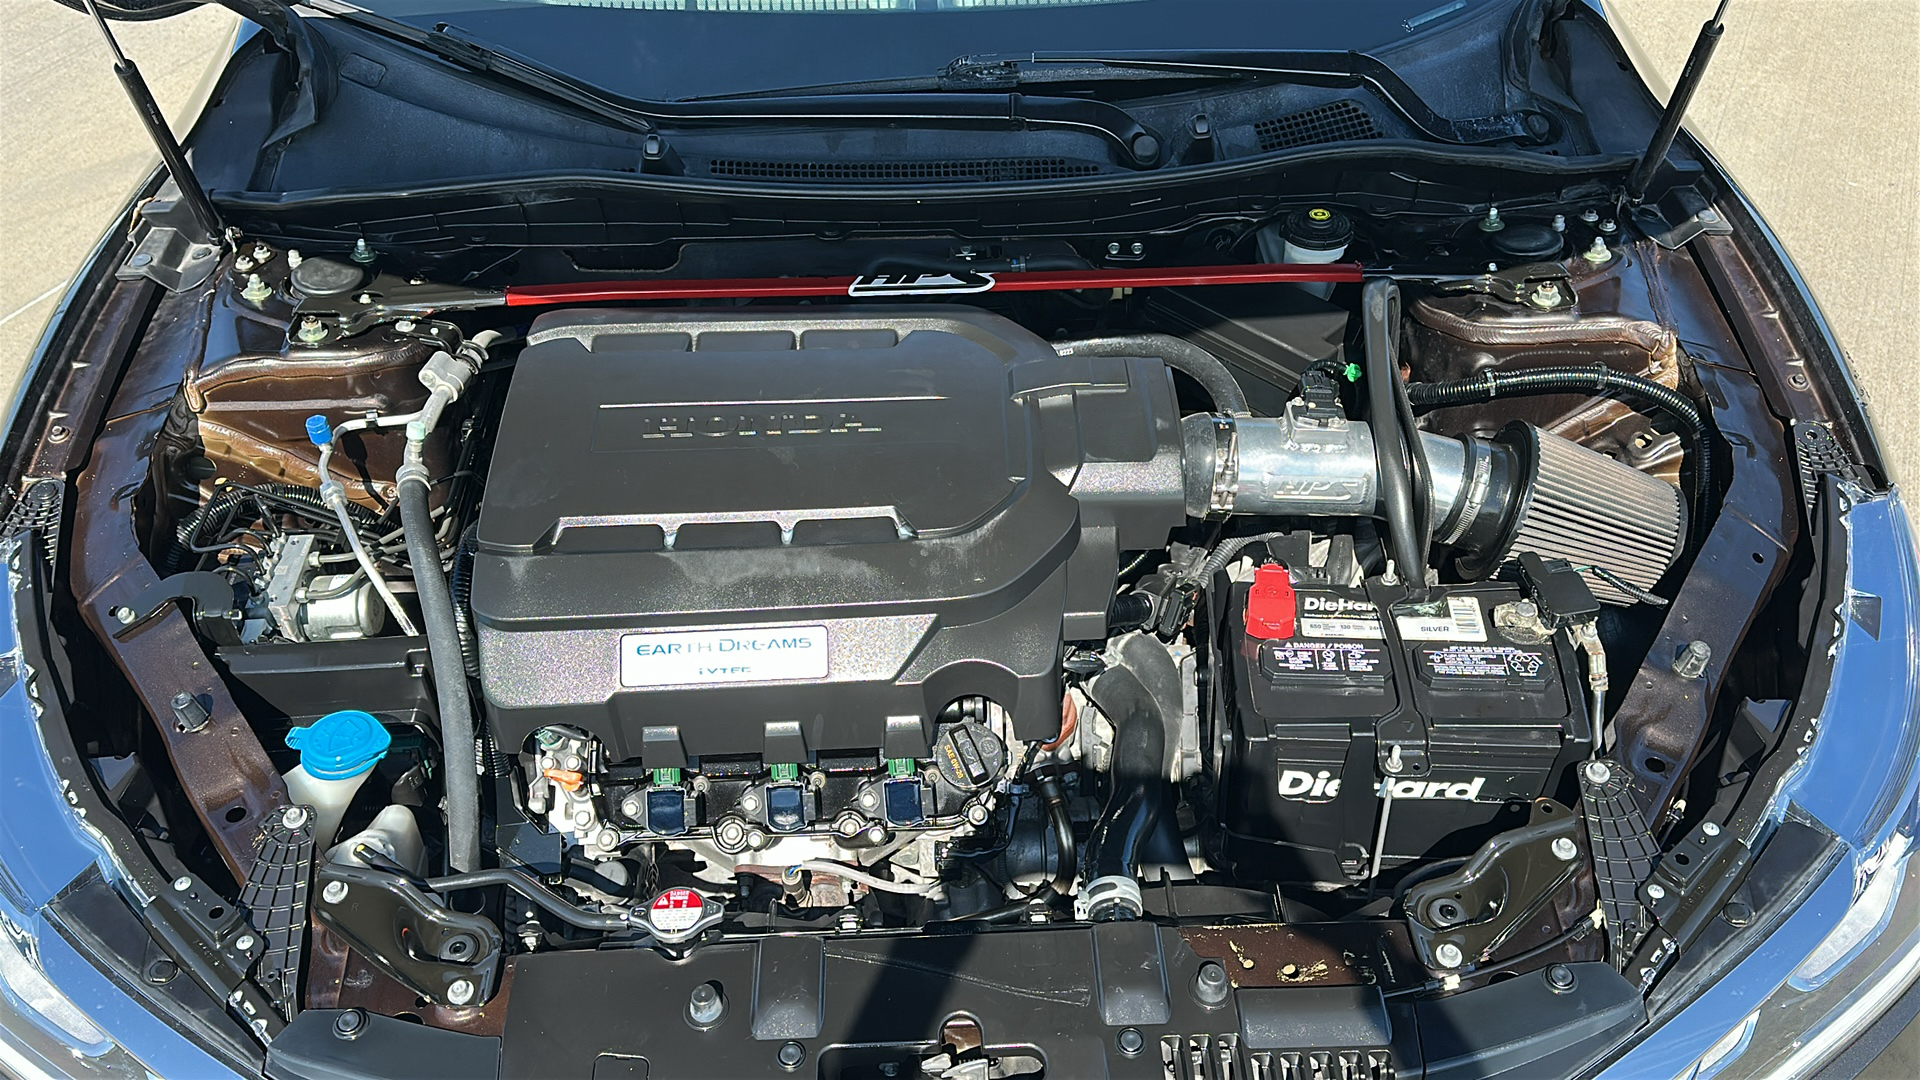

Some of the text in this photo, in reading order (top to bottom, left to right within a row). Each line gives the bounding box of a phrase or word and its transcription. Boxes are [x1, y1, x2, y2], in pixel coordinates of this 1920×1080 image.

[642, 412, 882, 439] HONDA
[1303, 597, 1376, 611] DieHar
[636, 638, 812, 656] EARTH DREAMS
[1293, 642, 1326, 650] DANGER
[944, 744, 956, 760] SAE
